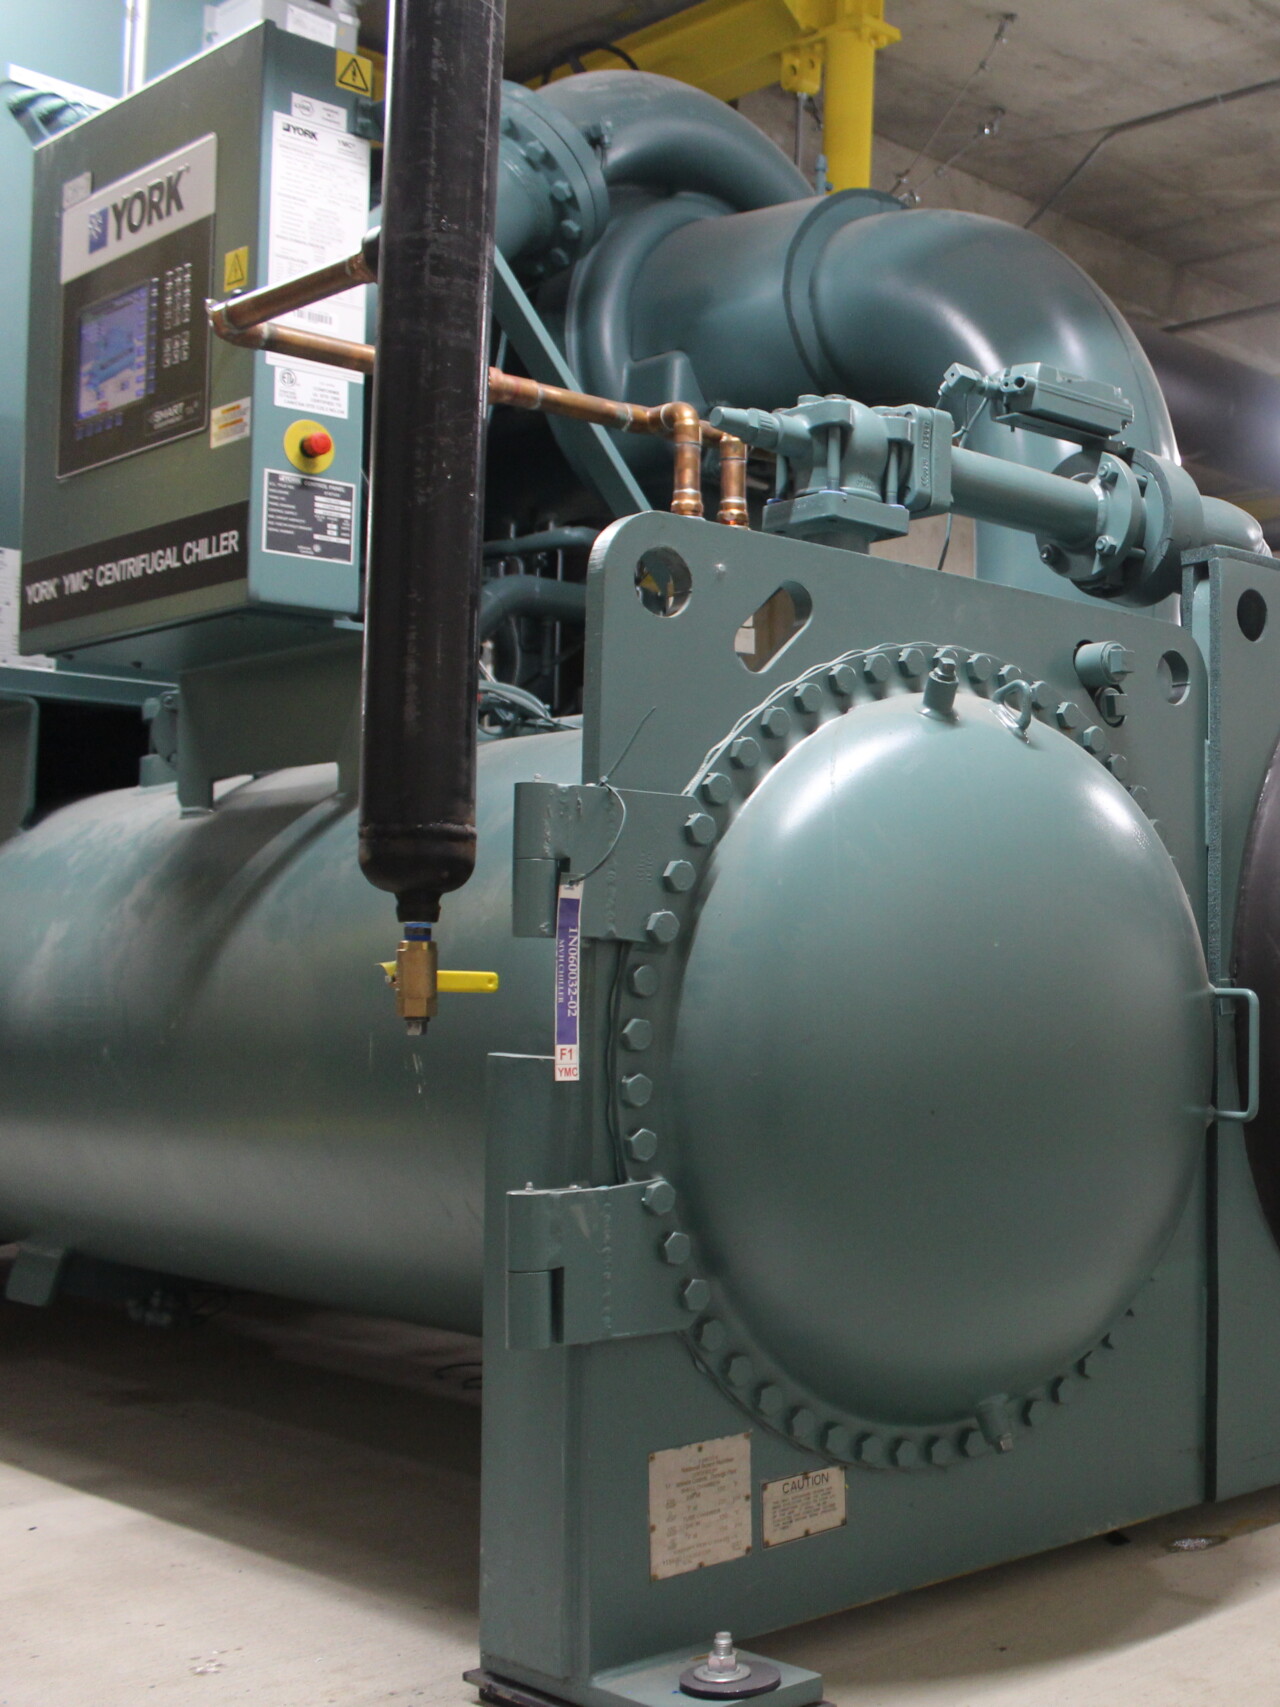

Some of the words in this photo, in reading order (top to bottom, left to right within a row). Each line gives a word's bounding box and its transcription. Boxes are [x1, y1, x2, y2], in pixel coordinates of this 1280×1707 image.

[290, 123, 318, 141] YORK
[111, 167, 186, 241] YORK
[96, 547, 181, 587] CENTRIFUGAL
[183, 530, 239, 565] CHILLER
[567, 927, 578, 1017] 1N060032-02
[560, 1048, 574, 1061] F1
[558, 1067, 578, 1077] YMC
[782, 1472, 829, 1494] CAUTION
